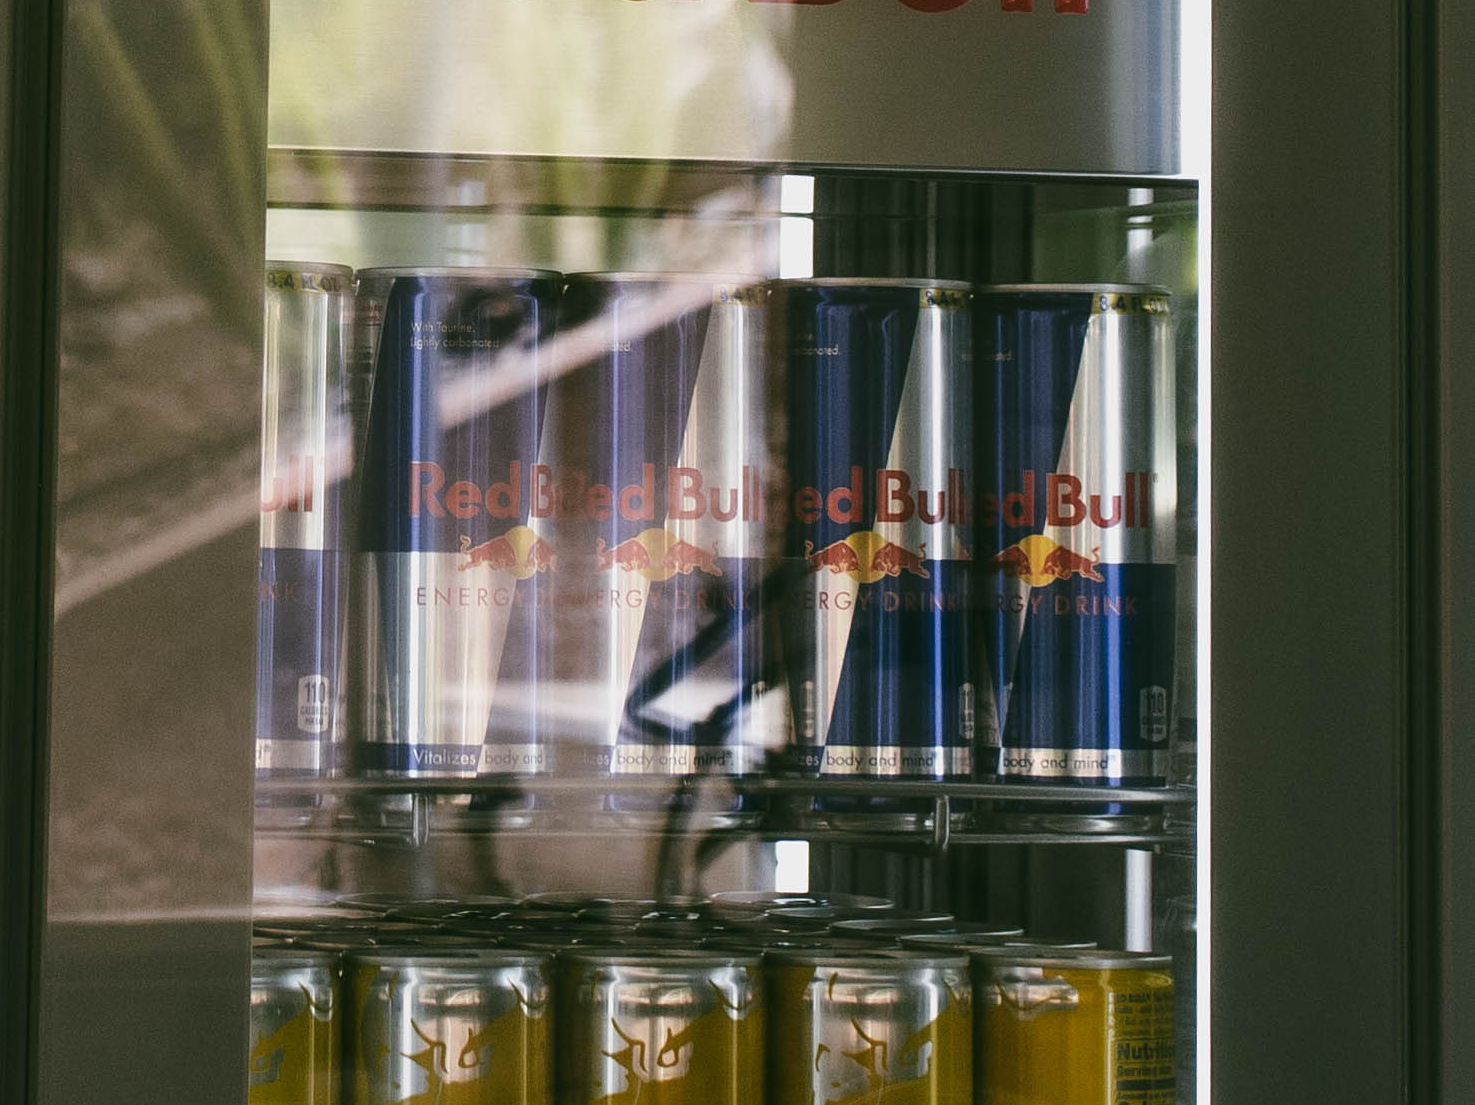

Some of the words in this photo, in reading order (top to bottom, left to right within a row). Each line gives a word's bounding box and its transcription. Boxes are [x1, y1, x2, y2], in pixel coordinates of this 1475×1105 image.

[409, 460, 521, 519] Red
[795, 465, 863, 524] ed
[981, 471, 1035, 528] ed
[1046, 472, 1149, 529] Bull
[413, 748, 476, 766] Vitalizes
[485, 749, 518, 770] body
[616, 749, 654, 769] body
[659, 750, 687, 767] and
[826, 749, 862, 771] body
[868, 751, 897, 767] and
[1003, 754, 1034, 774] body
[1040, 755, 1067, 770] and
